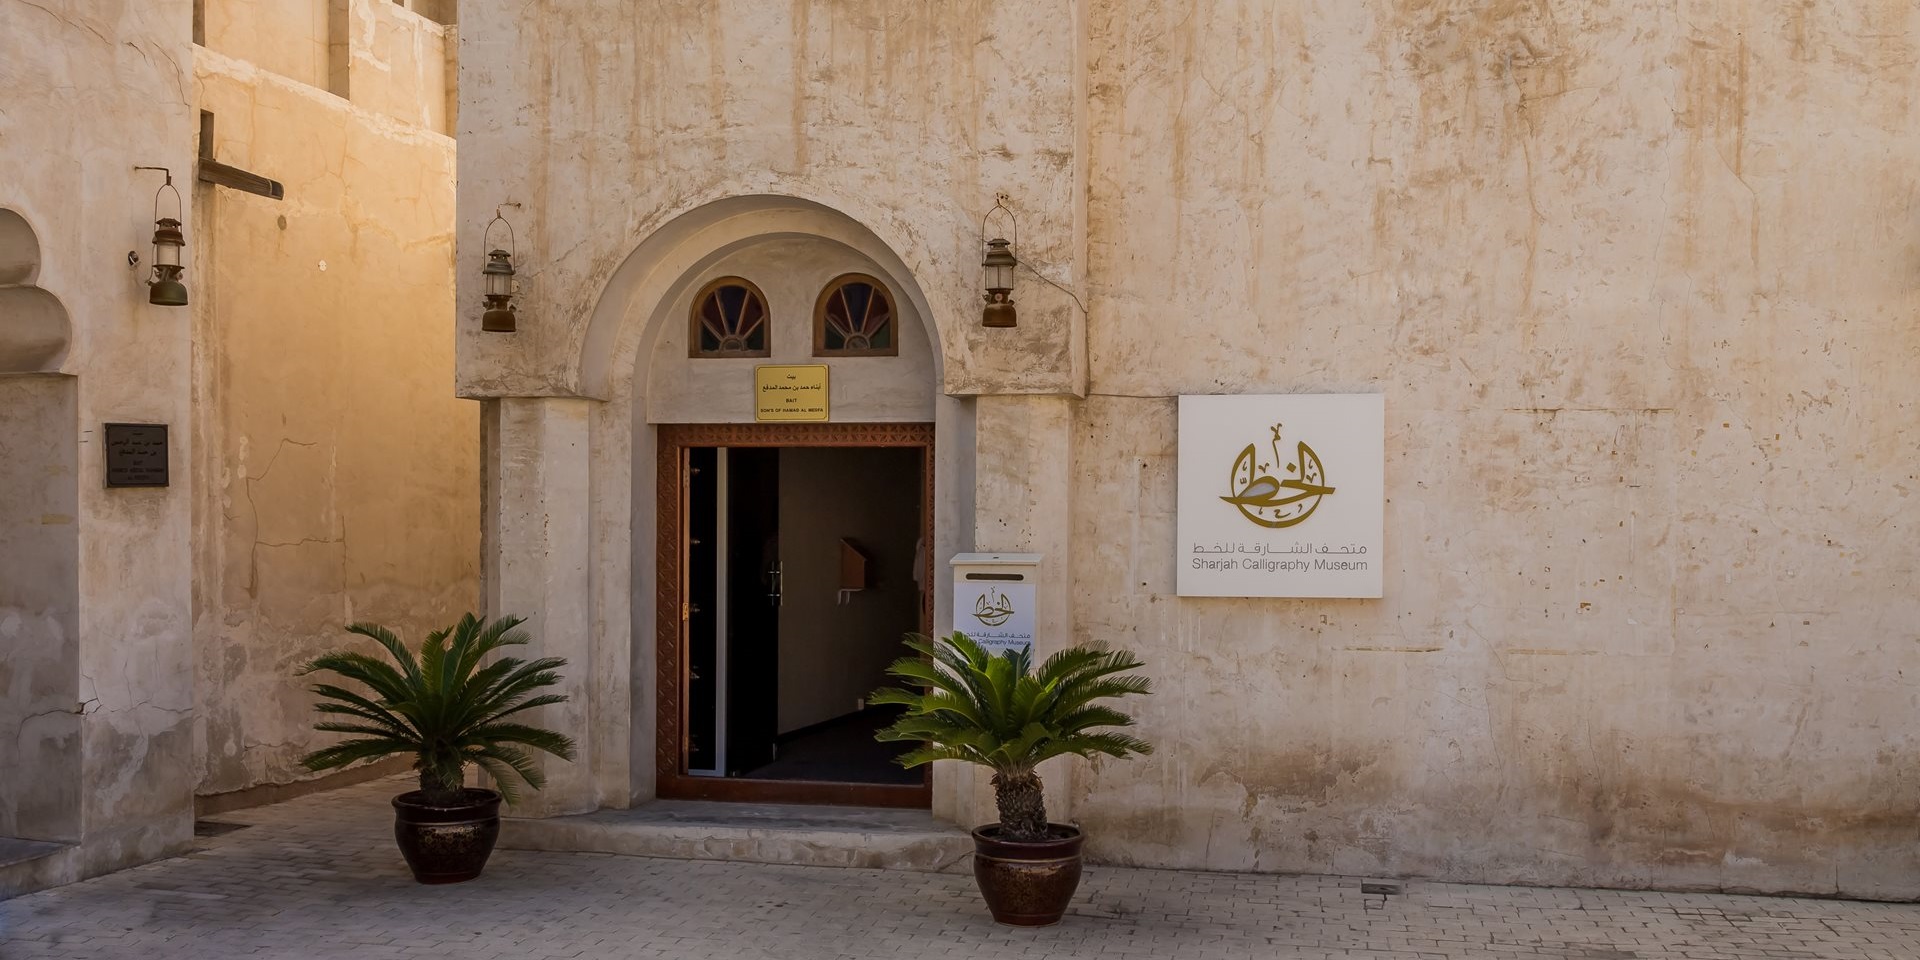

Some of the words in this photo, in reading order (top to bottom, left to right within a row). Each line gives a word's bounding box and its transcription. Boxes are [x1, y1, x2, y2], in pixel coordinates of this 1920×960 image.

[1192, 542, 1235, 554] للخط
[1237, 542, 1313, 556] الشارقة
[1315, 543, 1367, 554] متحف
[1192, 558, 1238, 571] Sharjah
[1242, 558, 1310, 572] Calligraphy
[1314, 559, 1368, 570] Museum
